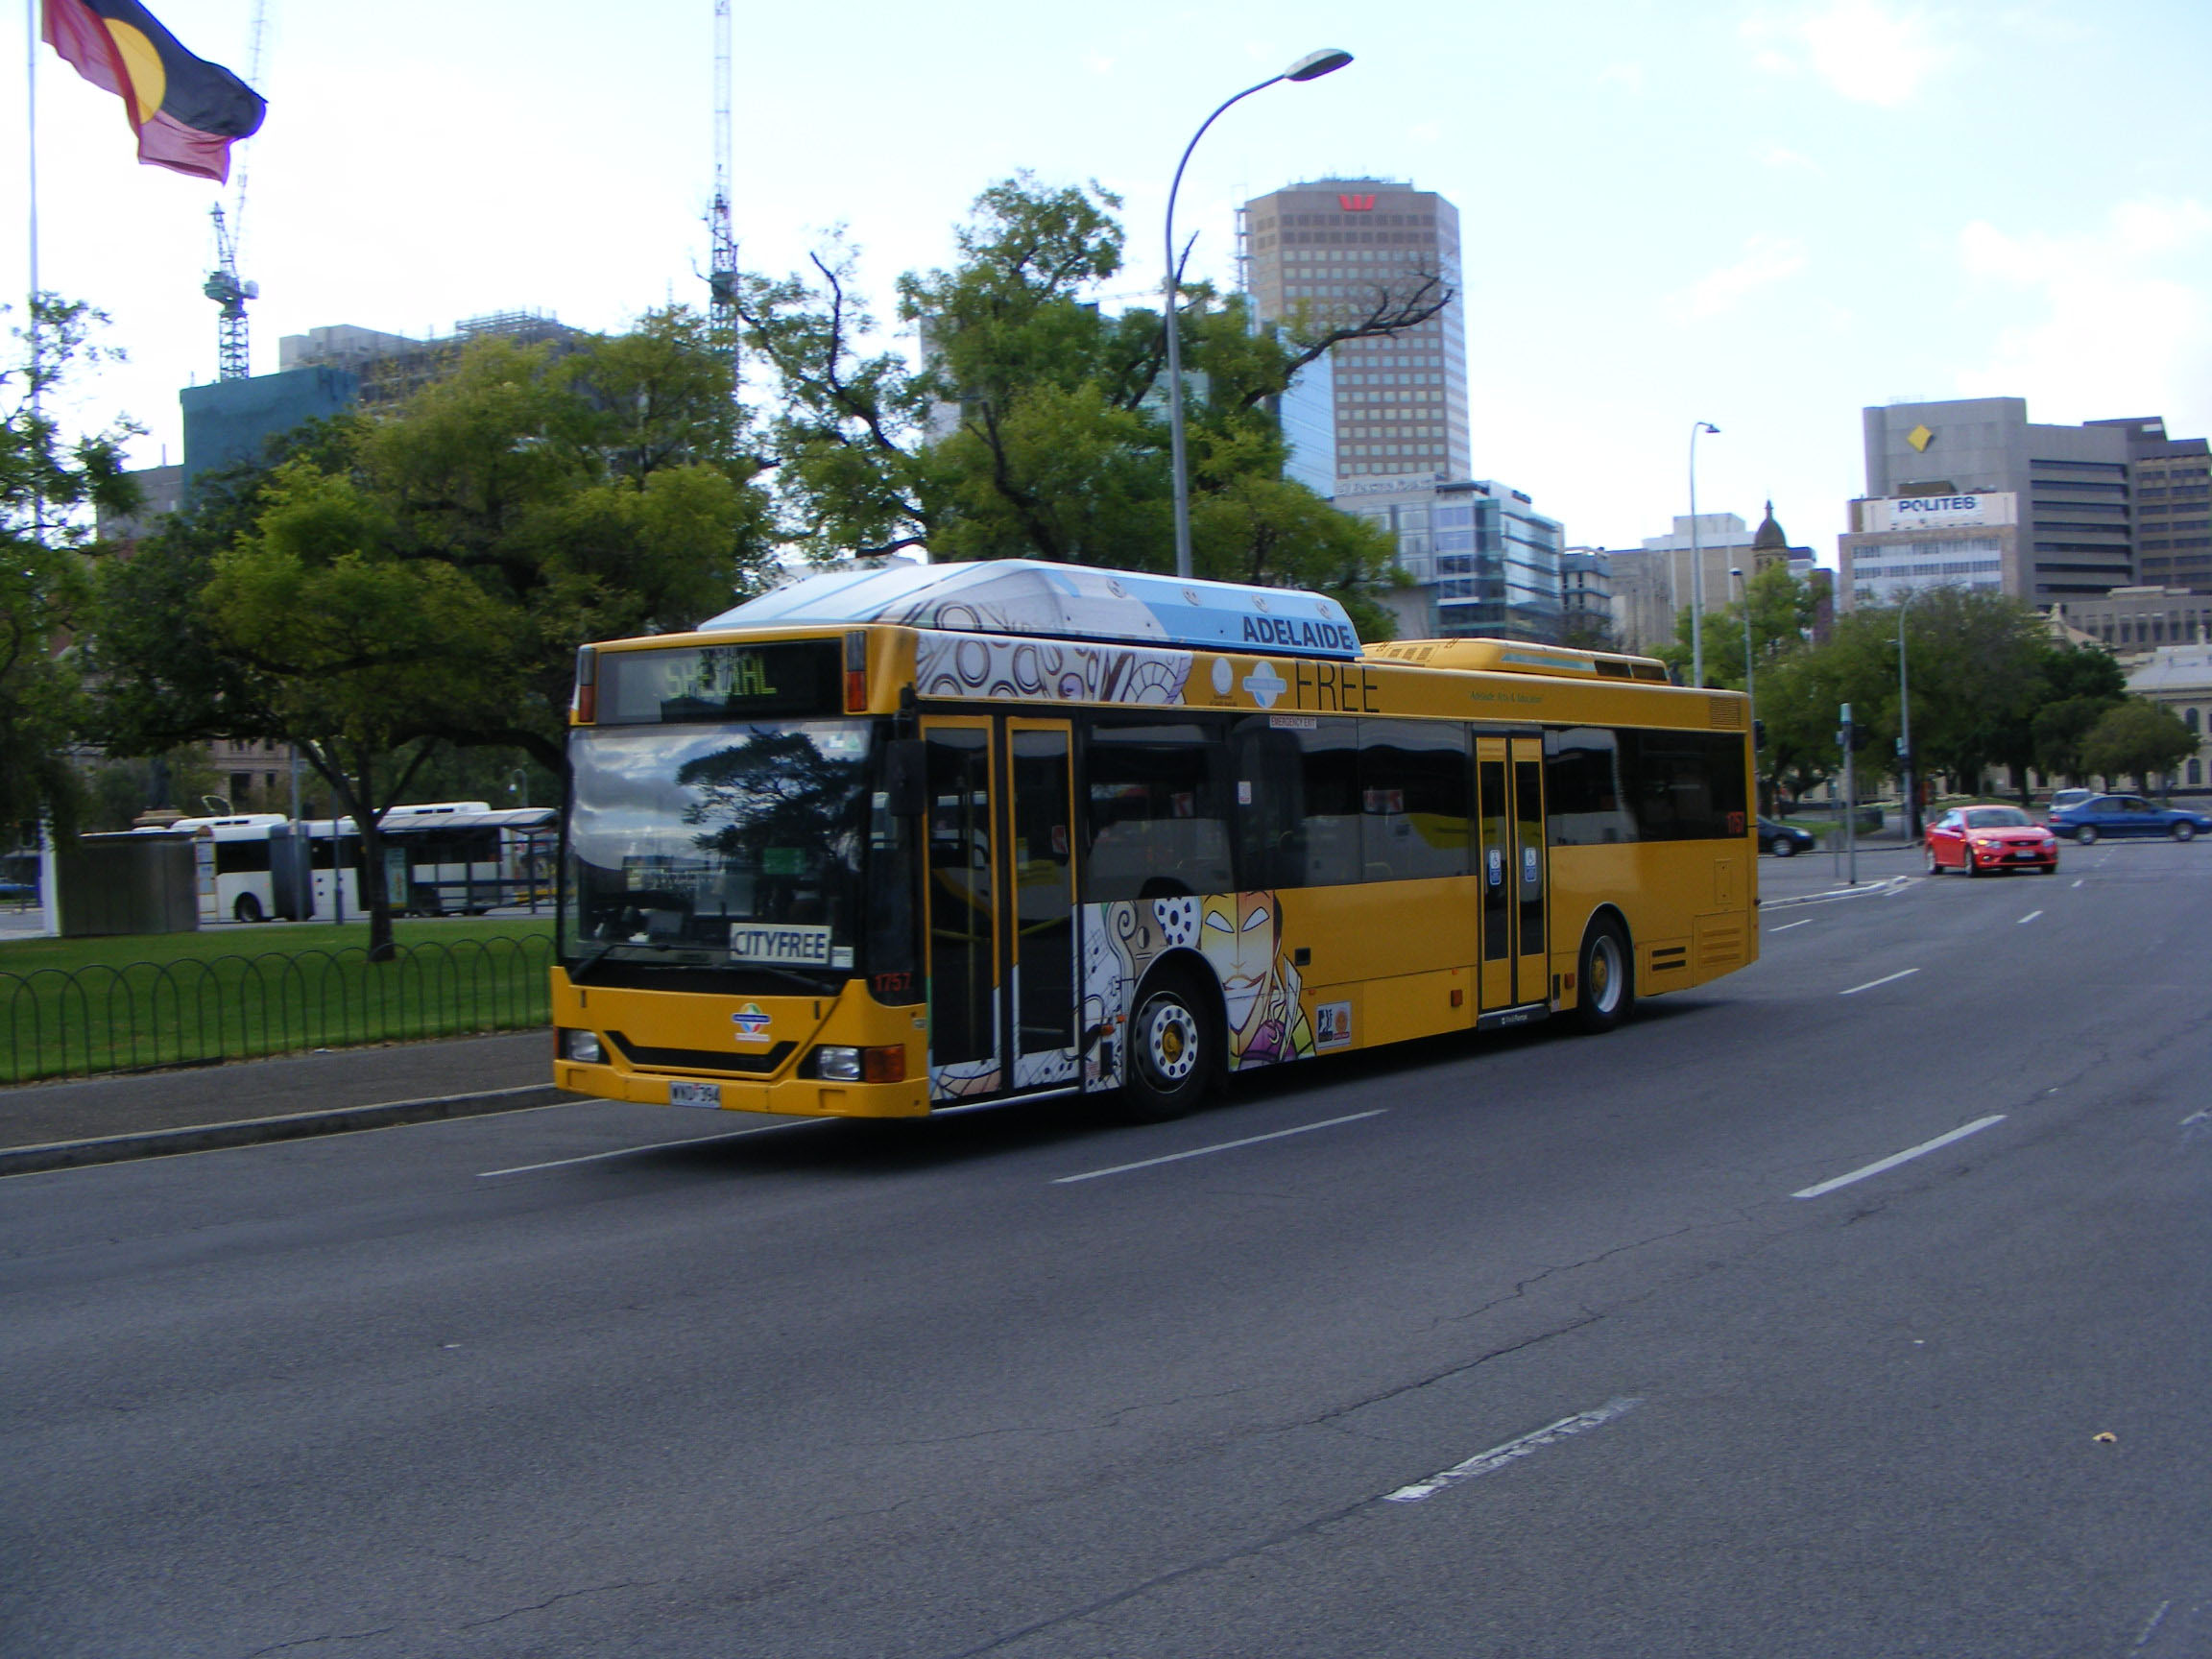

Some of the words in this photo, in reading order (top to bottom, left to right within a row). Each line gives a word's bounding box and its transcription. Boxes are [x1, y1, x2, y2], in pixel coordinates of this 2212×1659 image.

[1898, 495, 1976, 513] POLITES
[1243, 615, 1354, 650] ADELAIDE
[1295, 660, 1380, 712] FREE
[1271, 716, 1303, 727] EMERGENCY
[1304, 717, 1315, 728] EXIT
[734, 930, 828, 959] CITYFREE
[875, 972, 911, 992] 1757
